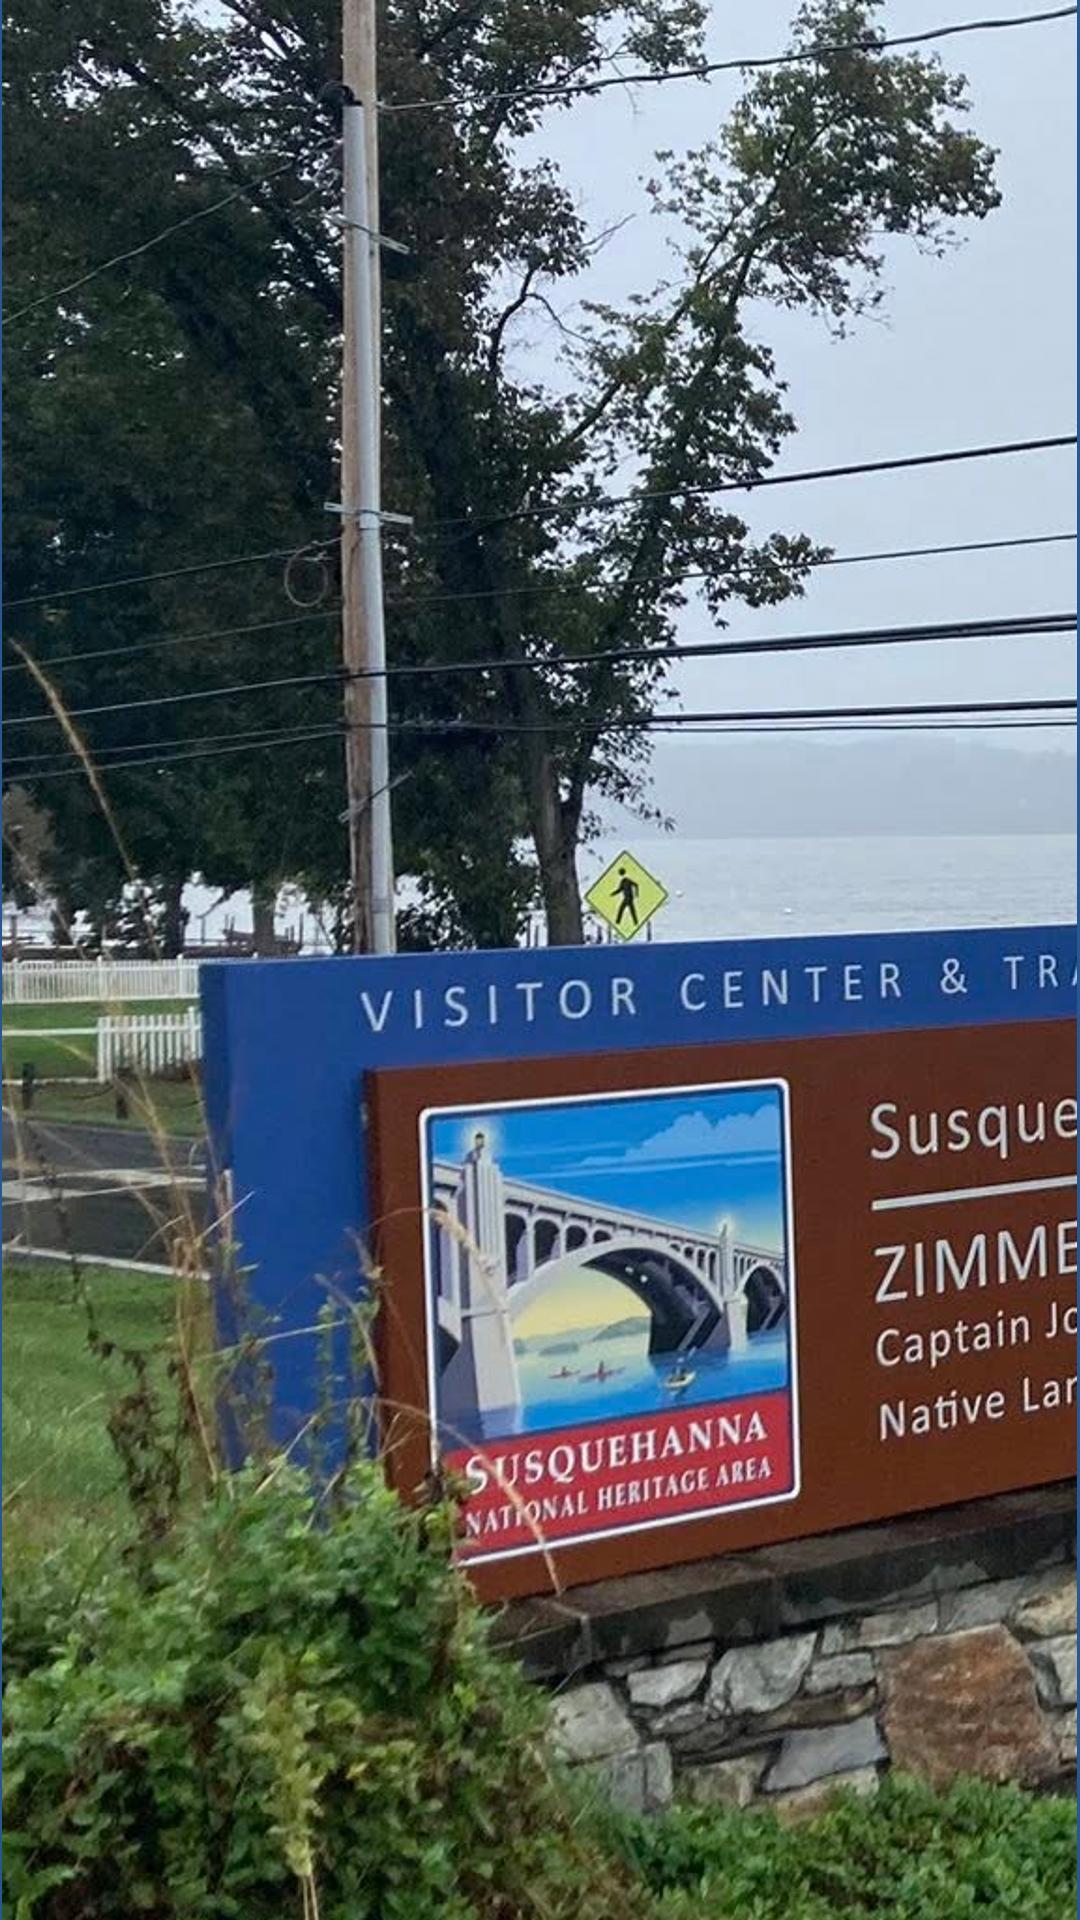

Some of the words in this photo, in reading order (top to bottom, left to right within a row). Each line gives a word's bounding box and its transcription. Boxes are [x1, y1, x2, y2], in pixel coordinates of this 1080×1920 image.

[360, 977, 637, 1032] VISITOR
[680, 963, 902, 1011] CENTER
[940, 957, 968, 995] &
[1003, 954, 1077, 990] TR
[870, 1098, 1077, 1160] Susque
[874, 1220, 1077, 1303] ZIMME
[876, 1309, 1030, 1369] Captain
[465, 1409, 768, 1496] SUSQUEHANNA
[879, 1389, 1006, 1441] Native
[465, 1490, 589, 1538] NATIONAL
[597, 1466, 709, 1511] HERITAGE
[715, 1455, 773, 1488] AREA
